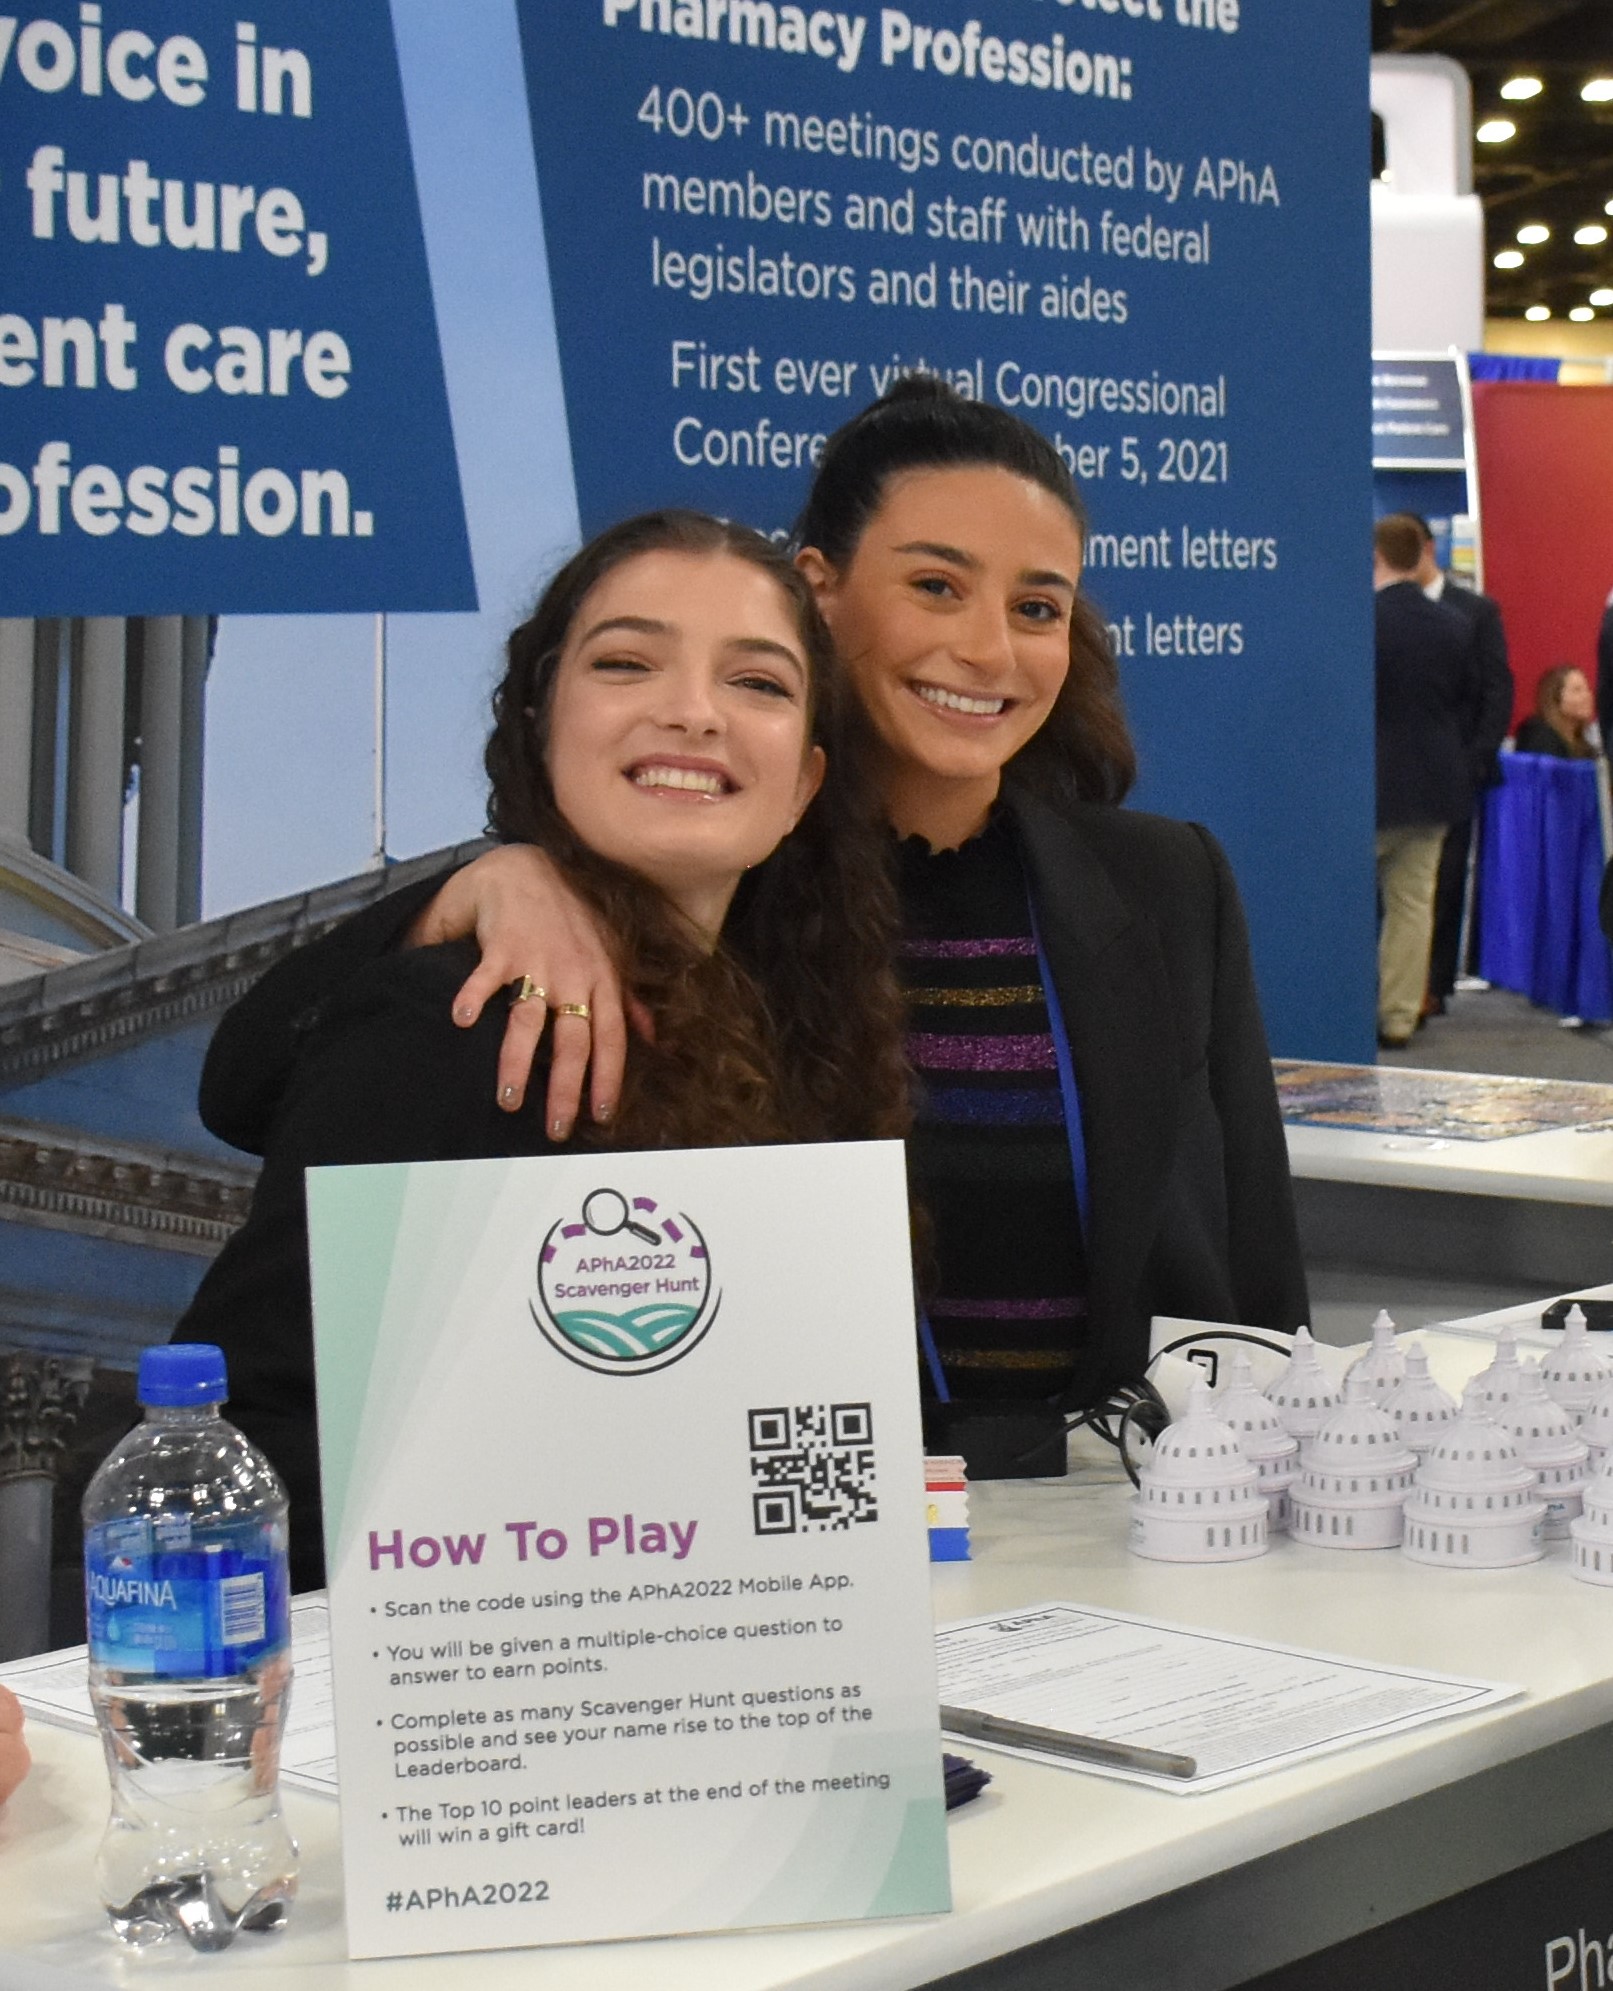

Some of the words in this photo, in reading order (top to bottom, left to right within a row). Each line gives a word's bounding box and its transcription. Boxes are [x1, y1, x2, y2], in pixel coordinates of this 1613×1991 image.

[237, 22, 312, 117] in
[880, 9, 1132, 100] Profession:
[638, 86, 749, 140] 400+
[765, 112, 939, 172] meetings
[952, 134, 1133, 189] conducted
[1145, 148, 1183, 203] by
[1194, 157, 1279, 206] APhA
[27, 145, 328, 276] future,
[644, 171, 831, 226] members
[845, 189, 913, 234] and
[927, 196, 1006, 242] staff
[1017, 205, 1089, 251] with
[1100, 210, 1209, 263] federal
[653, 237, 855, 301] legislators
[869, 263, 936, 308] and
[949, 266, 1030, 314] their
[1041, 275, 1127, 323] aides
[0, 303, 137, 391] ent
[164, 323, 352, 399] care
[673, 341, 761, 392] First
[775, 358, 857, 396] ever
[996, 361, 1224, 418] Congressional
[1120, 436, 1148, 486] 5,
[1158, 438, 1228, 483] 2021
[1083, 528, 1172, 568] ment
[1183, 525, 1278, 570] letters
[1146, 612, 1244, 656] letters
[555, 1282, 650, 1298] Scavenger
[656, 1277, 699, 1293] Hunt
[576, 1254, 675, 1273] APhA2022
[369, 1530, 486, 1570] How
[505, 1522, 567, 1561] To
[589, 1514, 697, 1560] Play
[385, 1601, 431, 1617] Scan
[439, 1599, 470, 1613] the
[477, 1594, 525, 1611] code
[532, 1593, 583, 1608] using
[590, 1588, 621, 1604] the
[628, 1579, 732, 1601] APhA2022
[739, 1576, 802, 1593] Mobile
[809, 1574, 853, 1590] App.
[387, 1646, 423, 1661] You
[431, 1641, 462, 1658] will
[470, 1641, 493, 1656] be
[500, 1638, 553, 1657] given
[560, 1638, 570, 1650] a
[577, 1625, 727, 1648] multiple-choice
[734, 1621, 816, 1639] question
[823, 1618, 842, 1632] to
[390, 1669, 459, 1685] answer
[466, 1666, 486, 1680] to
[493, 1664, 535, 1678] earn
[543, 1658, 608, 1677] points.
[391, 1710, 486, 1730] Complete
[493, 1710, 514, 1723] as
[521, 1706, 573, 1721] many
[581, 1698, 682, 1717] Scavenger
[690, 1692, 735, 1708] Hunt
[742, 1686, 834, 1707] questions
[841, 1685, 861, 1698] as
[394, 1734, 474, 1756] possible
[481, 1731, 517, 1747] and
[525, 1731, 557, 1745] see
[564, 1727, 606, 1745] your
[614, 1723, 666, 1738] name
[674, 1719, 707, 1733] rise
[714, 1717, 733, 1731] to
[740, 1714, 770, 1729] the
[777, 1713, 810, 1728] top
[816, 1707, 835, 1724] of
[842, 1707, 872, 1722] the
[396, 1754, 526, 1778] Leaderboard.
[396, 1806, 432, 1821] The
[439, 1803, 475, 1820] Top
[481, 1800, 502, 1816] 10
[509, 1797, 559, 1817] point
[567, 1792, 636, 1809] leaders
[644, 1789, 661, 1804] at
[669, 1787, 699, 1802] the
[707, 1782, 742, 1800] end
[749, 1779, 768, 1796] of
[775, 1780, 805, 1794] the
[813, 1774, 890, 1790] meeting
[399, 1829, 430, 1846] will
[438, 1827, 472, 1843] win
[479, 1828, 489, 1841] a
[497, 1822, 529, 1842] gift
[536, 1818, 584, 1836] card!
[387, 1880, 549, 1912] #APhA2022
[1545, 1928, 1613, 1991] Ph
